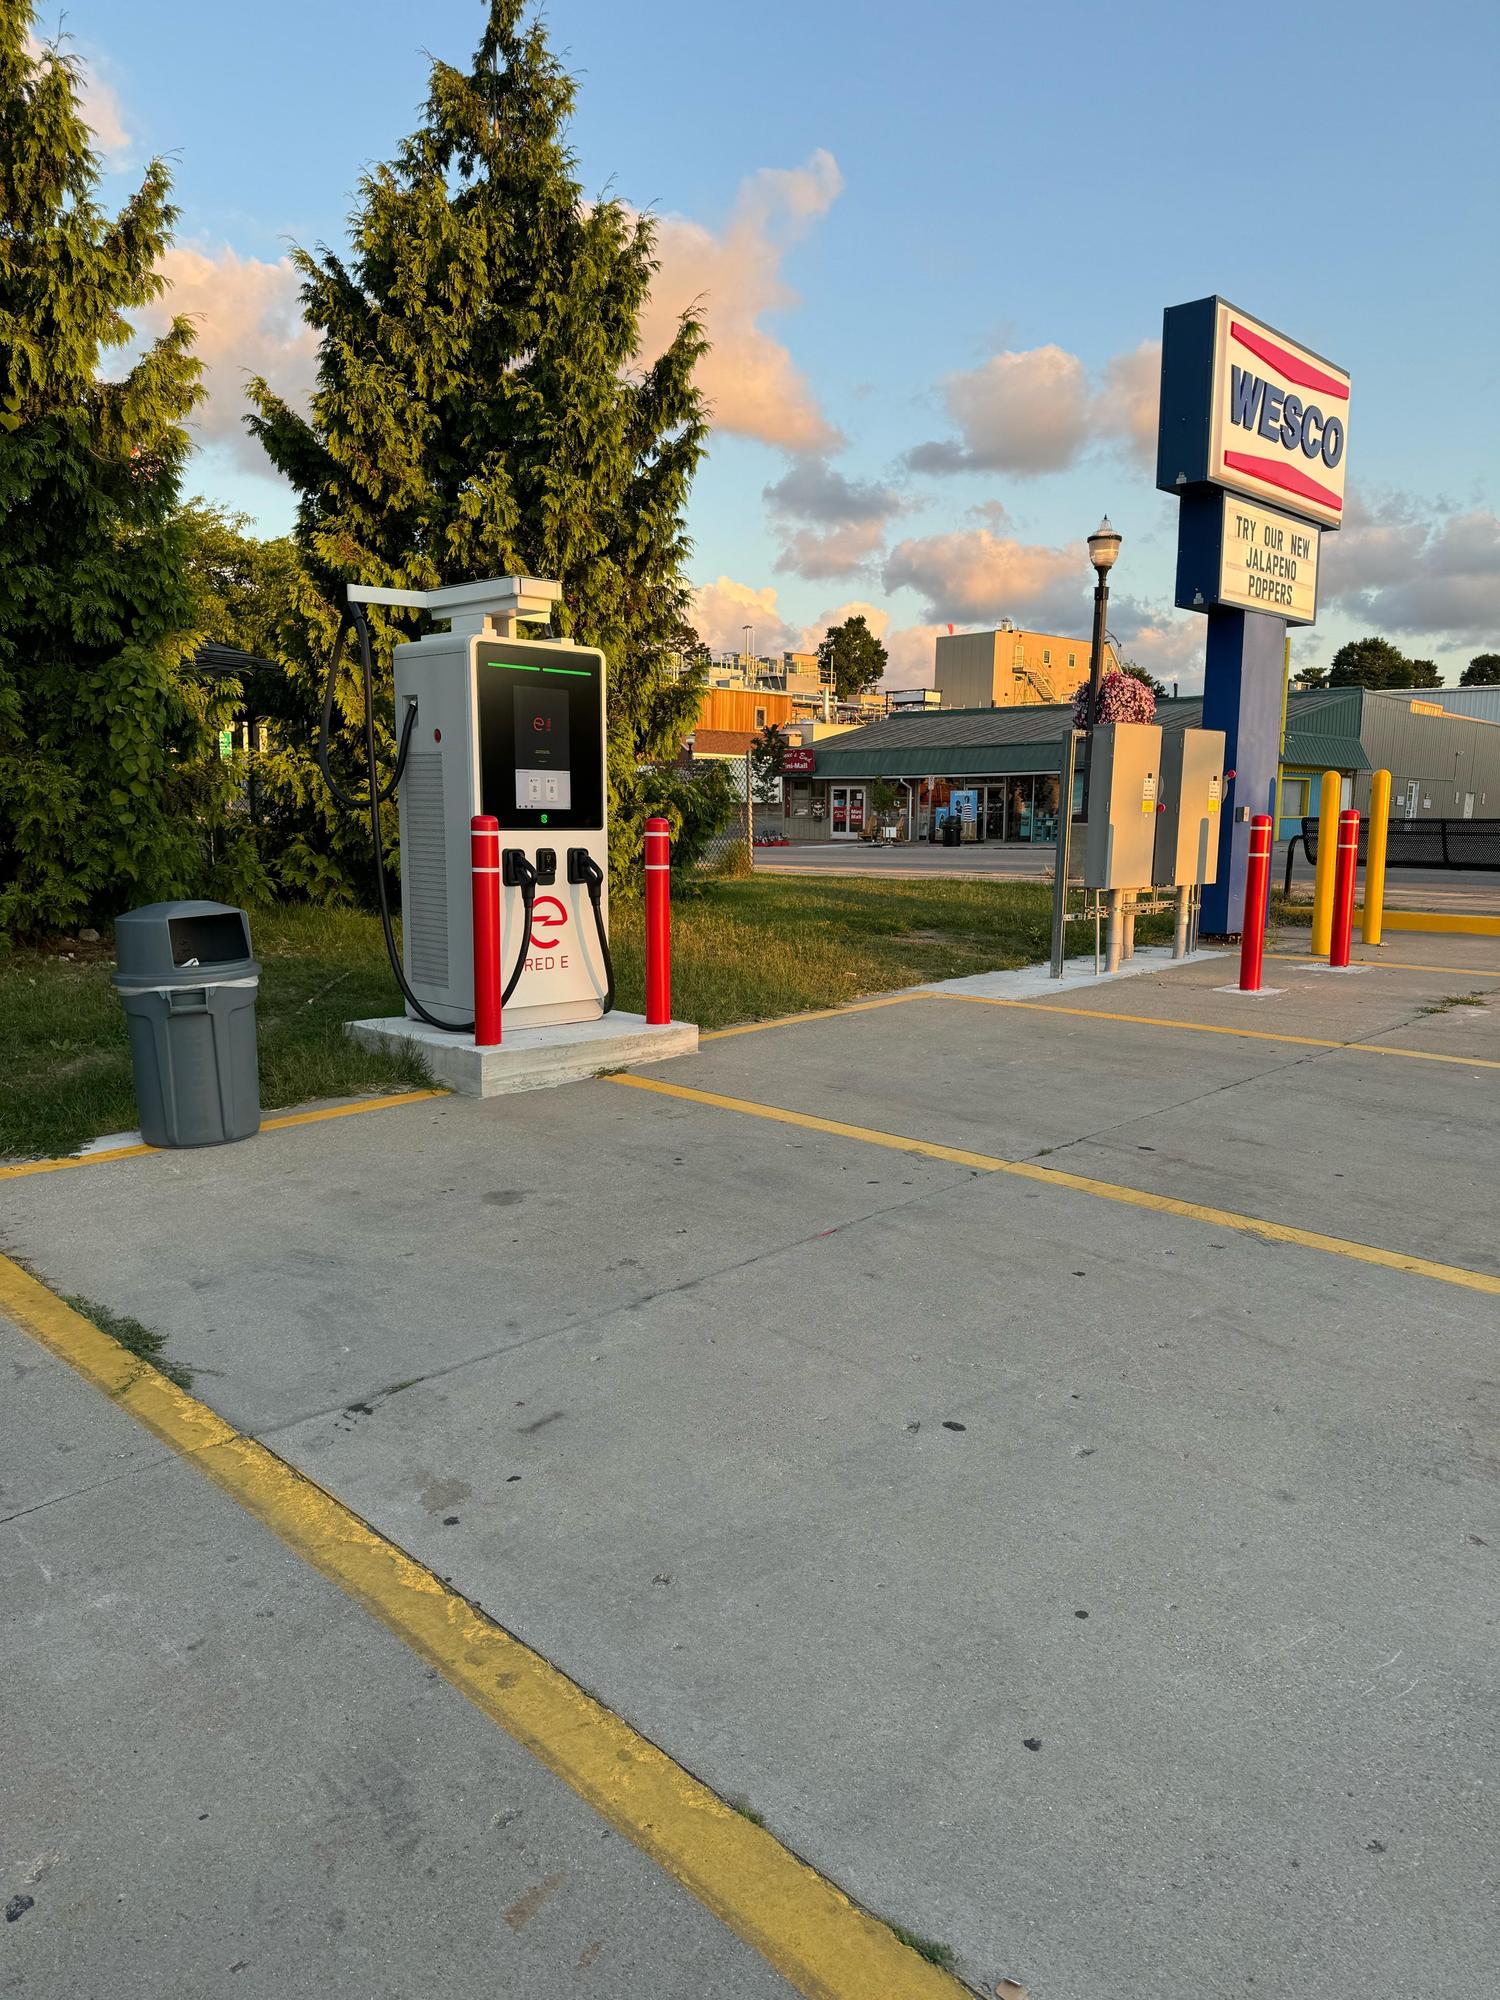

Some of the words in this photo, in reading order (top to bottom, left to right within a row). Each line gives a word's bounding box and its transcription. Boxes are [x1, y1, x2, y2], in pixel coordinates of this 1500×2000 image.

[1231, 364, 1344, 469] WESCO
[1236, 516, 1256, 542] TRY
[1264, 525, 1283, 551] OUR
[1291, 534, 1310, 559] NEW
[1246, 547, 1296, 580] JALAPENO
[1248, 574, 1292, 605] POPPERS
[524, 956, 555, 972] RED
[560, 955, 569, 968] E
